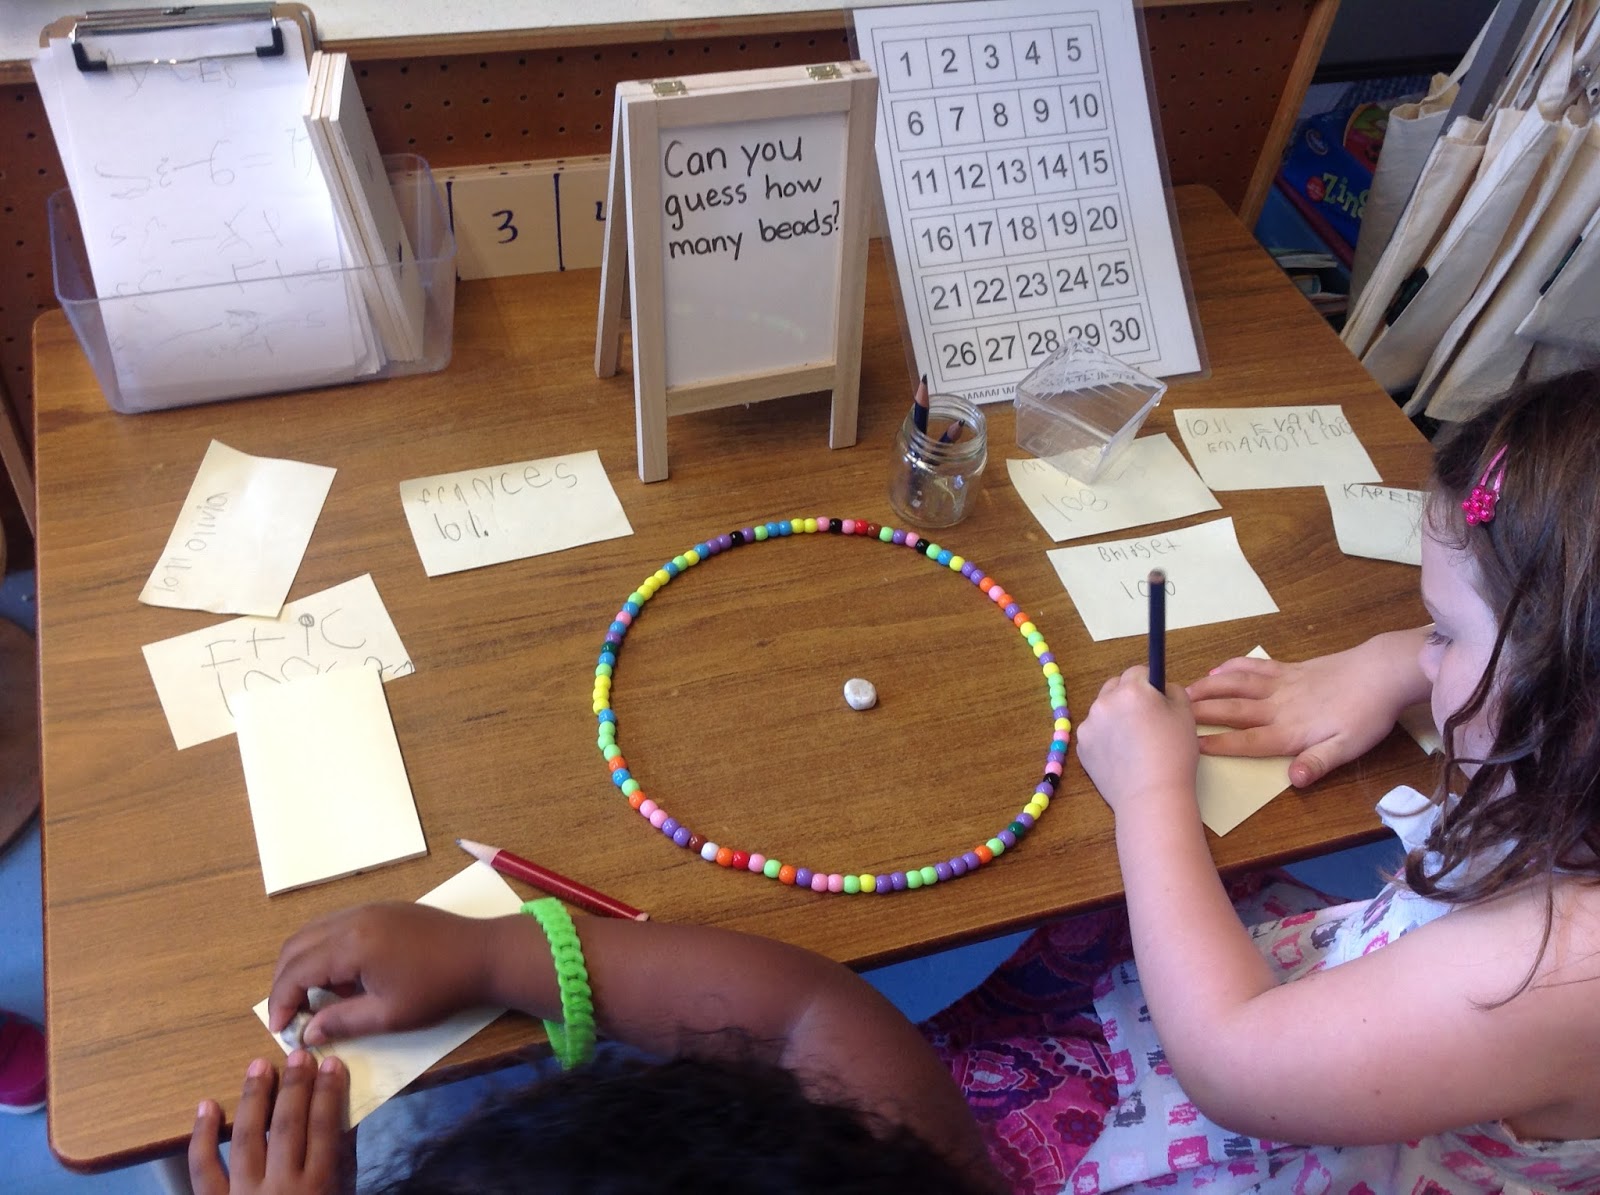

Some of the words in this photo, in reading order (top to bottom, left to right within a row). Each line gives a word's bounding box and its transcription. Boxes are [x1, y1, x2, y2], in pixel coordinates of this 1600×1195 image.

[899, 51, 912, 77] 1
[940, 48, 958, 74] 2
[983, 44, 1000, 70] 3
[1024, 40, 1041, 65] 4
[1066, 37, 1082, 62] 5
[907, 110, 925, 137] 6
[949, 106, 965, 132] 7
[992, 102, 1009, 128] 8
[1033, 98, 1050, 123] 9
[1068, 93, 1099, 119] 10
[664, 139, 727, 178] Can
[740, 136, 802, 177] you
[911, 168, 938, 195] 11
[953, 163, 986, 190] 12
[995, 158, 1027, 185] 13
[1036, 153, 1068, 180] 14
[1077, 149, 1109, 175] 15
[664, 183, 747, 231] guess
[765, 174, 822, 199] how
[491, 209, 518, 244] 3
[669, 232, 743, 261] many
[758, 200, 840, 242] beads?
[921, 226, 954, 253] 16
[963, 220, 993, 248] 17
[1006, 216, 1038, 242] 18
[1046, 210, 1078, 237] 19
[1086, 205, 1118, 232] 20
[930, 283, 962, 311] 21
[973, 277, 1008, 305] 22
[1015, 272, 1049, 299] 23
[1056, 266, 1089, 294] 24
[1097, 260, 1130, 287] 25
[942, 341, 977, 369] 26
[985, 334, 1016, 363] 27
[1027, 329, 1061, 356] 28
[1109, 317, 1141, 344] 30
